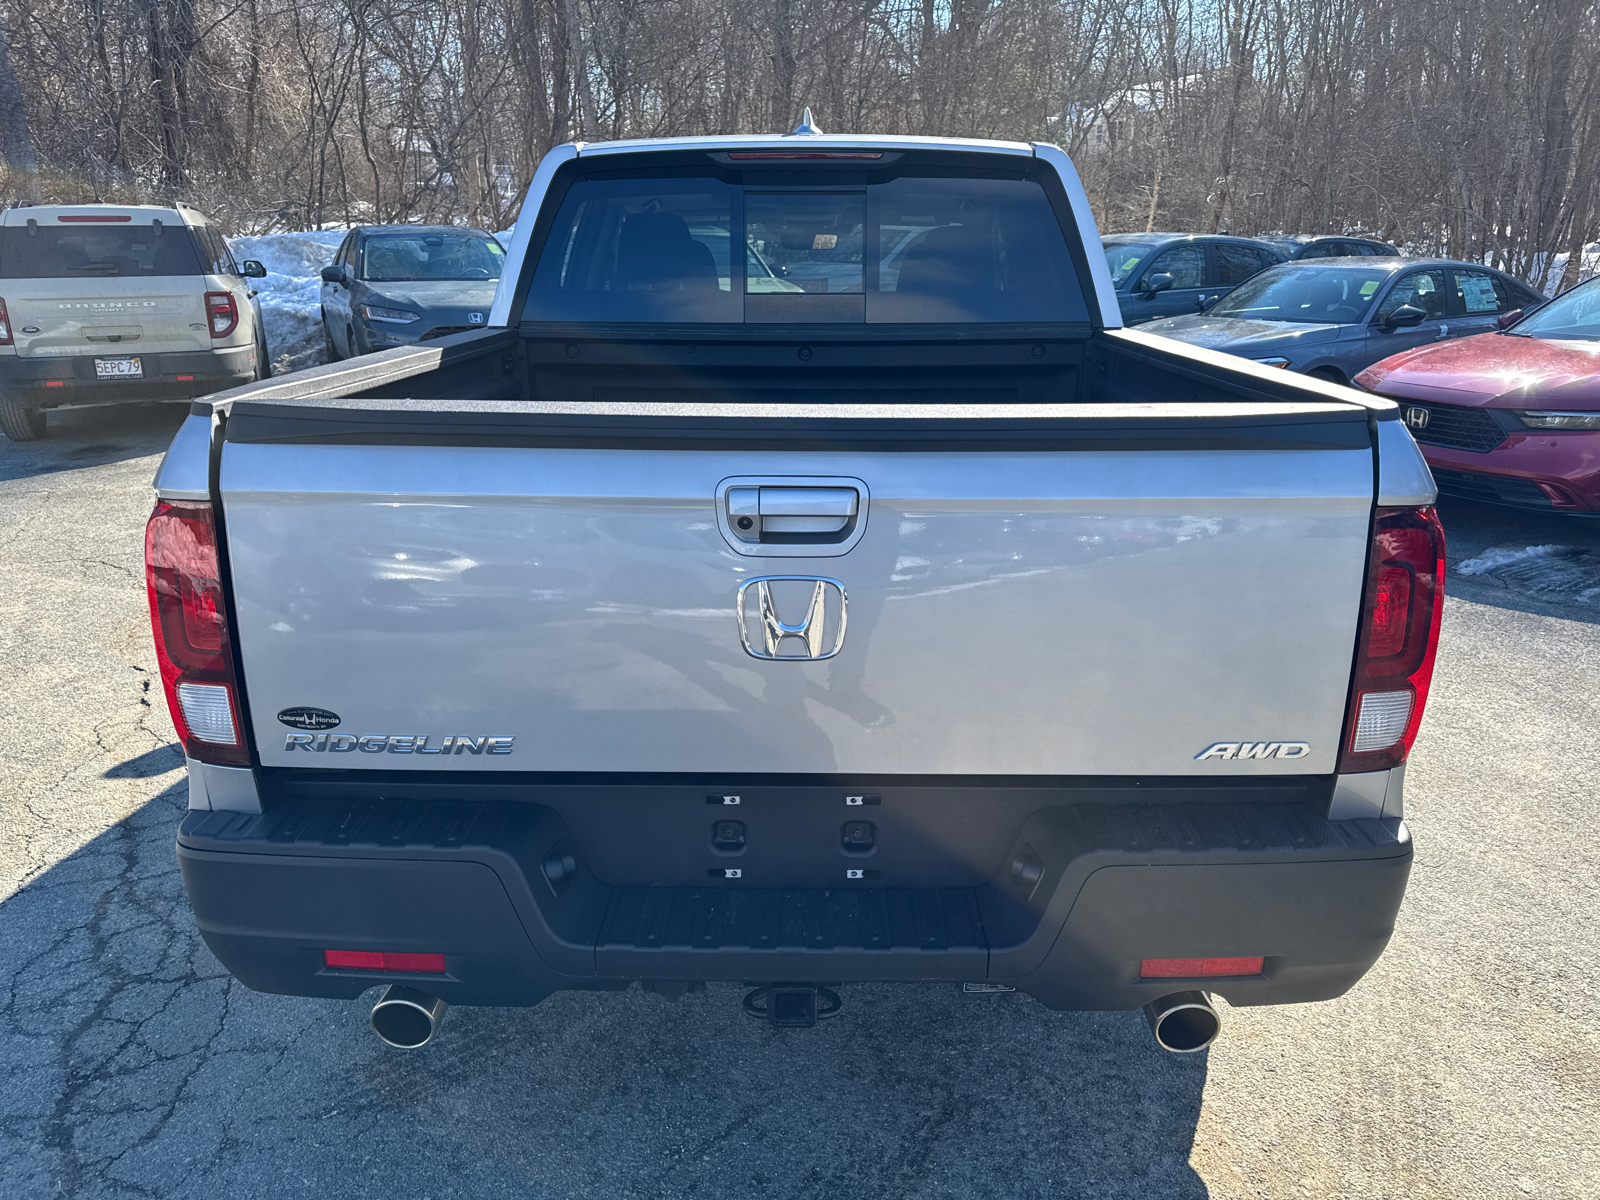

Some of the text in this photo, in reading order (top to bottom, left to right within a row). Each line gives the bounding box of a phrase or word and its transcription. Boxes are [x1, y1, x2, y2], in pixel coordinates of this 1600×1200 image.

[58, 301, 156, 309] BRONCO
[96, 361, 140, 374] 5EPC 79
[278, 714, 305, 722] Colonial
[315, 716, 340, 724] Honda
[284, 733, 515, 755] RIDGELINE
[1193, 741, 1312, 760] AWD
